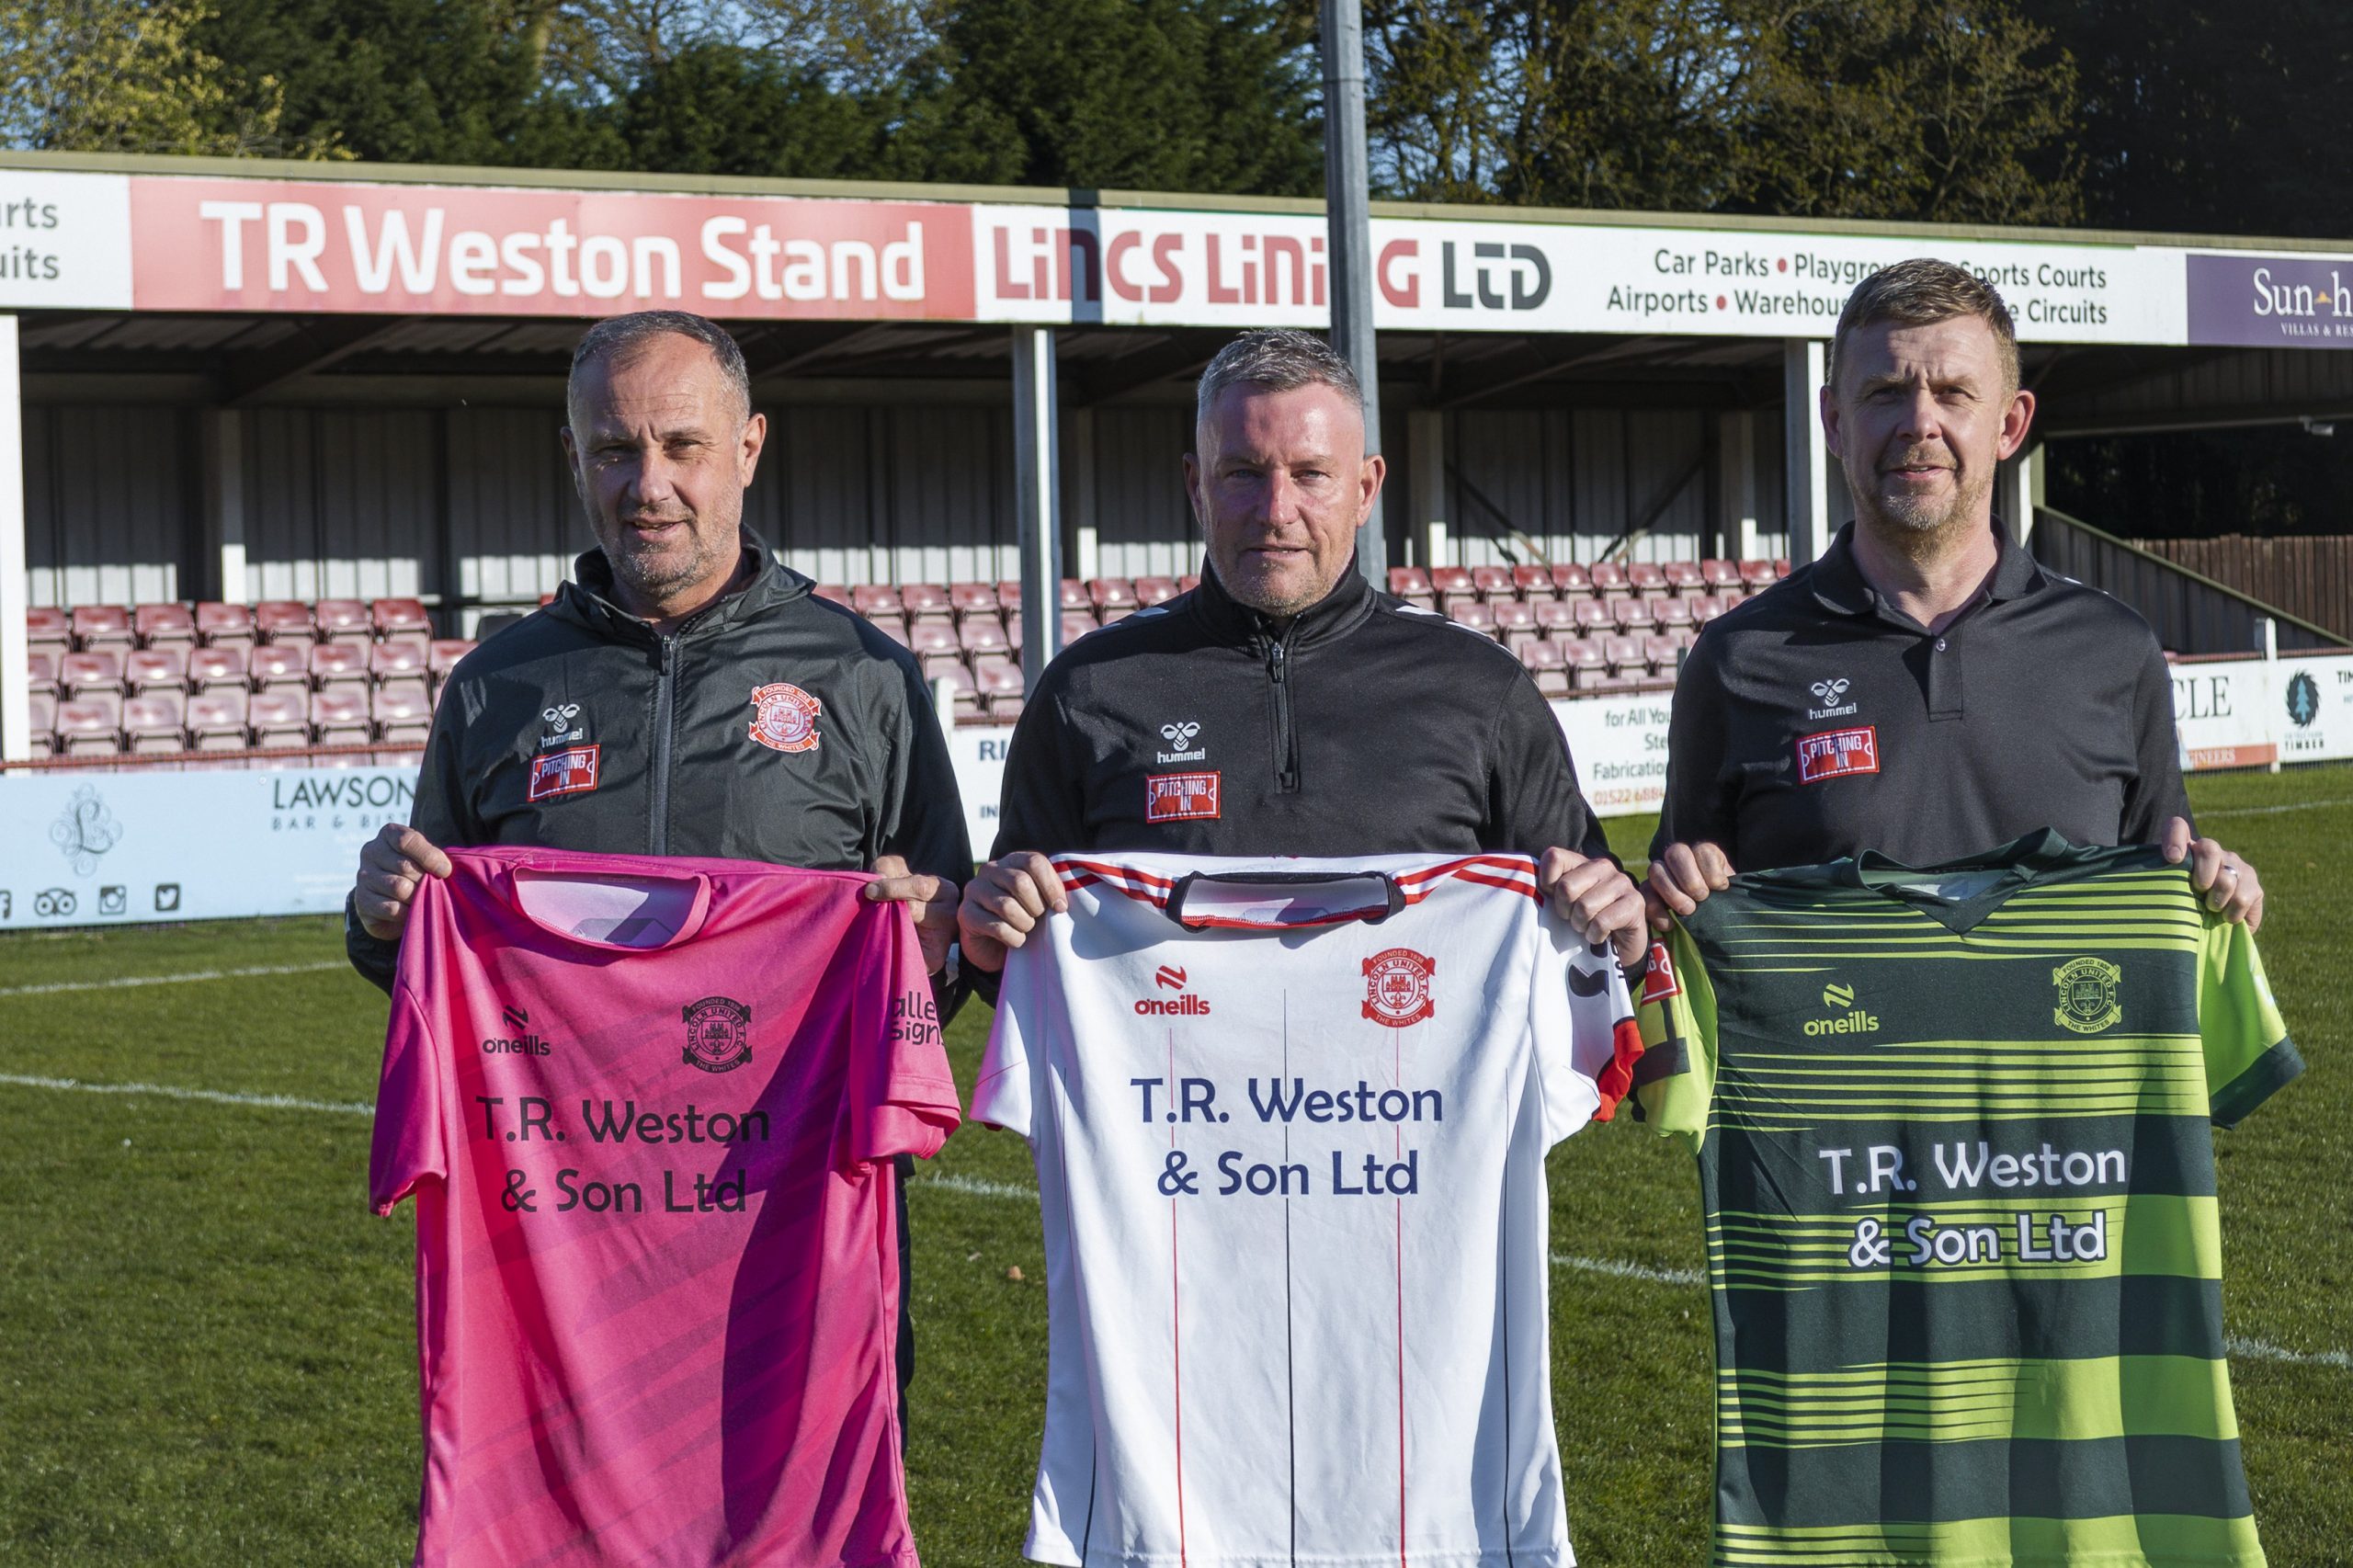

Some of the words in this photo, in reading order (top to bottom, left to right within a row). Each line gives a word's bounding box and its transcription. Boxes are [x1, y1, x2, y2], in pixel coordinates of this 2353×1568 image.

[0, 197, 59, 229] rts
[199, 200, 329, 292] TR
[343, 205, 682, 299] Weston
[701, 216, 926, 302] Stand
[1654, 248, 1696, 274] Car
[1705, 250, 1769, 277] Parks
[1795, 254, 1890, 285] Playgro
[2037, 264, 2107, 288] Courts
[1608, 285, 1708, 316] Airports
[2028, 300, 2107, 324] Circuits
[2280, 322, 2320, 336] VILLAS
[763, 685, 795, 696] FOUNDED
[759, 695, 779, 730] LINCOLN
[780, 695, 810, 717] UNITED
[1605, 710, 1625, 727] for
[1628, 708, 1646, 725] All
[1809, 702, 1858, 720] hummel
[541, 727, 584, 748] hummel
[1810, 734, 1862, 759] PITCHING
[541, 754, 586, 778] PITCHING
[1157, 747, 1206, 764] hummel
[1836, 751, 1849, 767] IN
[559, 769, 571, 786] IN
[1158, 779, 1207, 798] PITCHING
[273, 776, 419, 810] LAWSON
[1180, 795, 1192, 812] IN
[1372, 949, 1408, 964] FOUNDED
[2063, 959, 2095, 973] FOUNDED
[1370, 961, 1390, 1005] LINCOLN
[1392, 960, 1427, 982] UNITED
[2061, 971, 2078, 1012] LINCOLN
[2081, 968, 2112, 988] UNITED
[692, 998, 725, 1012] FOUNDED
[689, 1009, 709, 1051] LINCOLN
[710, 1007, 743, 1028] UNITED
[1375, 1014, 1391, 1025] THE
[1392, 1013, 1421, 1027] WHITES
[2068, 1020, 2082, 1031] THE
[2083, 1019, 2110, 1032] WHITES
[890, 1020, 945, 1045] sign
[696, 1059, 710, 1071] THE
[712, 1060, 741, 1073] WHITES
[1131, 1077, 1230, 1124] T.R.
[1247, 1077, 1443, 1124] Weston
[476, 1095, 566, 1143] T.R.
[582, 1098, 770, 1145] Weston
[1157, 1150, 1199, 1197] &
[1218, 1150, 1310, 1197] Son
[1332, 1149, 1418, 1196] Ltd
[1819, 1144, 1916, 1195] T.R.
[1934, 1141, 2126, 1190] Weston
[501, 1168, 538, 1213] &
[556, 1168, 642, 1213] Son
[665, 1170, 747, 1213] Ltd
[1849, 1218, 1891, 1267] &
[1906, 1216, 2000, 1266] Son
[2018, 1210, 2107, 1263] Ltd
